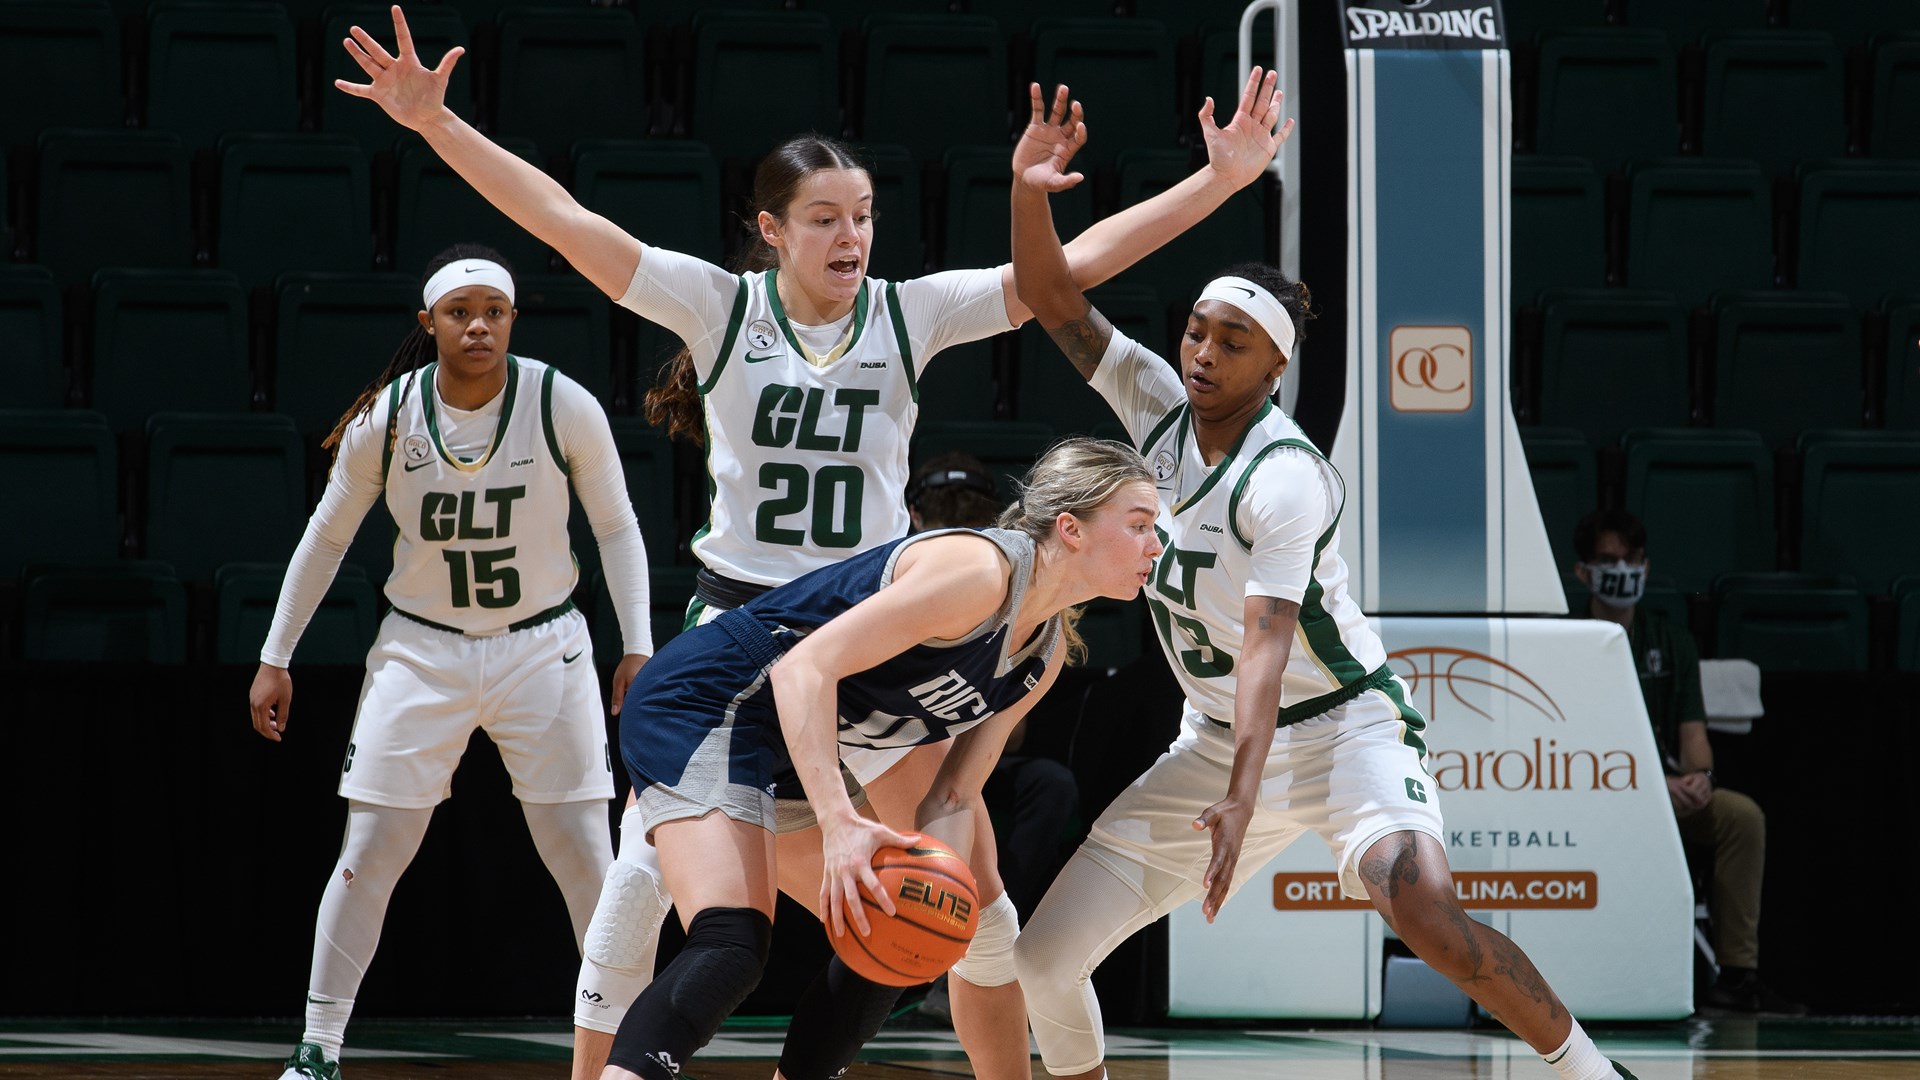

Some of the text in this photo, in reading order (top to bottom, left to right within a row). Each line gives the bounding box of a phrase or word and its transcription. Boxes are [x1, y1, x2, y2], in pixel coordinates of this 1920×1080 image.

[1347, 7, 1496, 41] SPALDING
[751, 383, 880, 453] CLT
[420, 485, 526, 541] CLT
[756, 462, 864, 548] 20
[442, 546, 521, 609] 15
[1601, 570, 1640, 598] CLT
[1147, 596, 1235, 678] 13
[1428, 737, 1639, 791] arolina
[1443, 831, 1577, 847] KETBALL
[899, 876, 971, 923] ELITE
